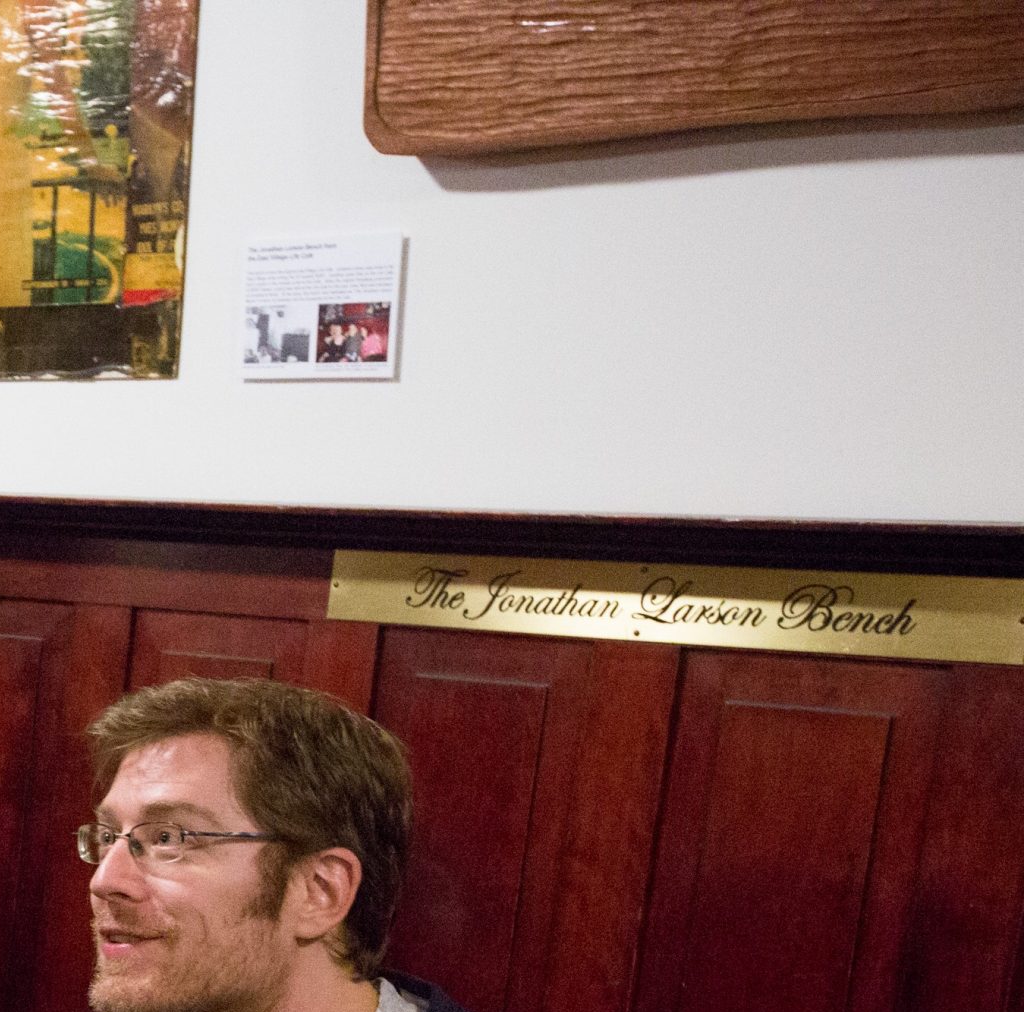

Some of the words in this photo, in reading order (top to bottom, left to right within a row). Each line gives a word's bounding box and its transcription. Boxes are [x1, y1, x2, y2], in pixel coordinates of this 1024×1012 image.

[405, 566, 469, 610] The
[463, 569, 624, 620] Jonathan
[631, 576, 767, 626] Larson
[778, 584, 917, 636] Bench
